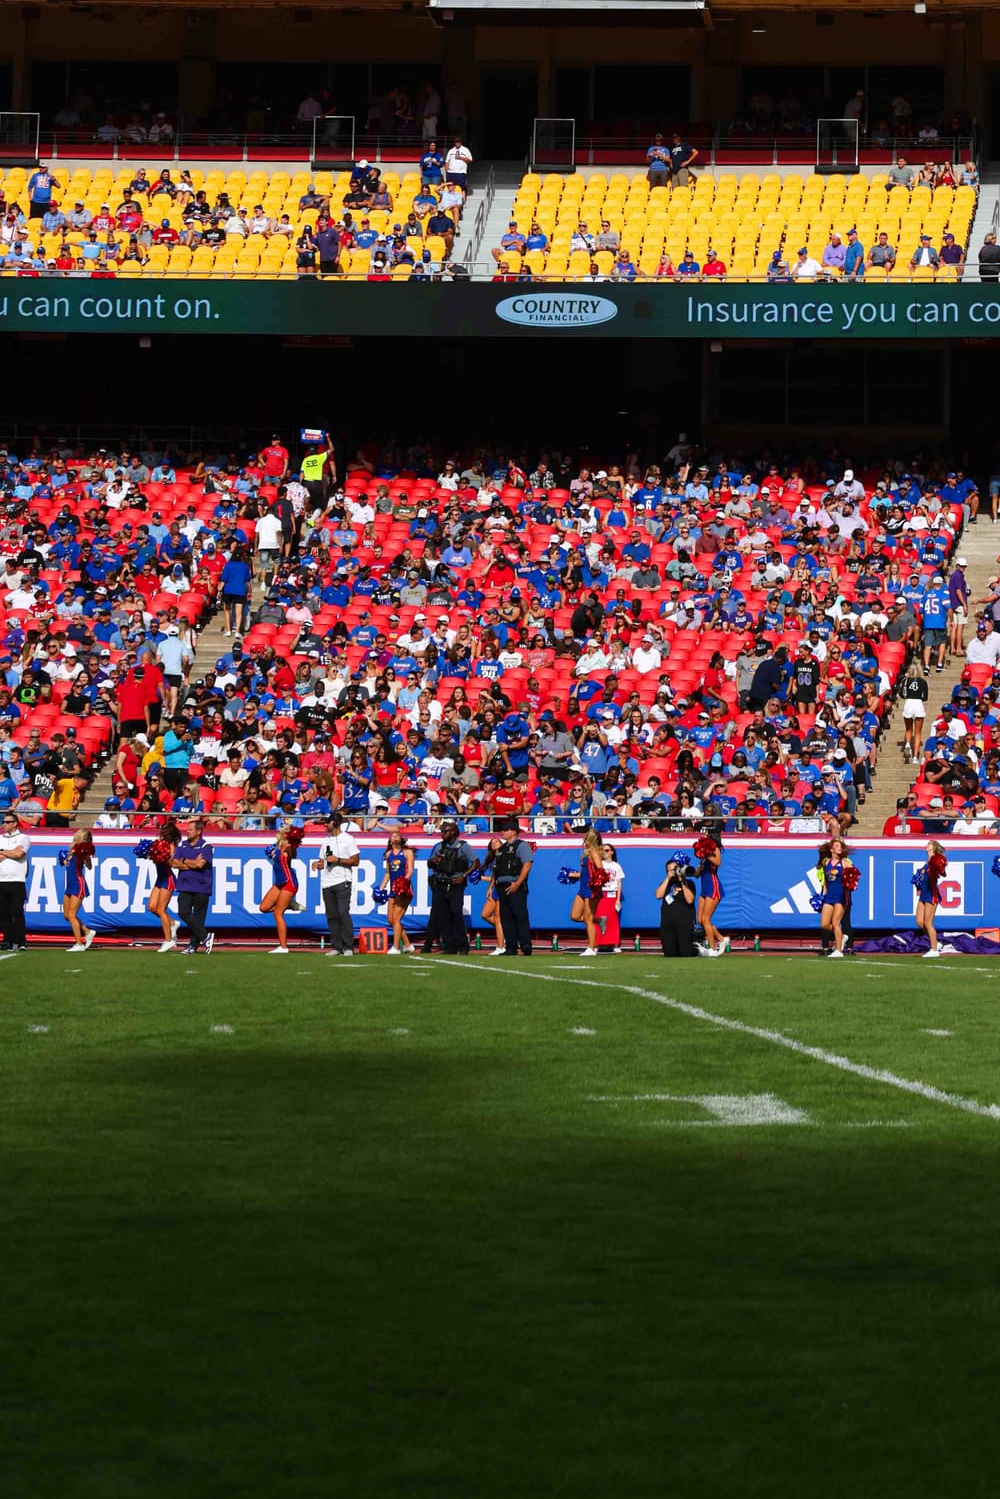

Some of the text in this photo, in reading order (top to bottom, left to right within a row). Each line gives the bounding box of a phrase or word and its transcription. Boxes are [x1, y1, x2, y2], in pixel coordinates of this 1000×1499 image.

[18, 297, 69, 317] can
[79, 294, 166, 319] count
[174, 299, 220, 319] on.
[512, 298, 600, 315] COUNTRY
[688, 296, 834, 323] Insurance
[841, 303, 896, 326] you
[906, 302, 959, 323] can
[529, 313, 588, 322] FINANCIAL
[924, 598, 940, 615] 45
[908, 681, 918, 692] 4
[584, 744, 600, 757] 47
[344, 785, 364, 800] 32
[363, 931, 384, 951] 10
